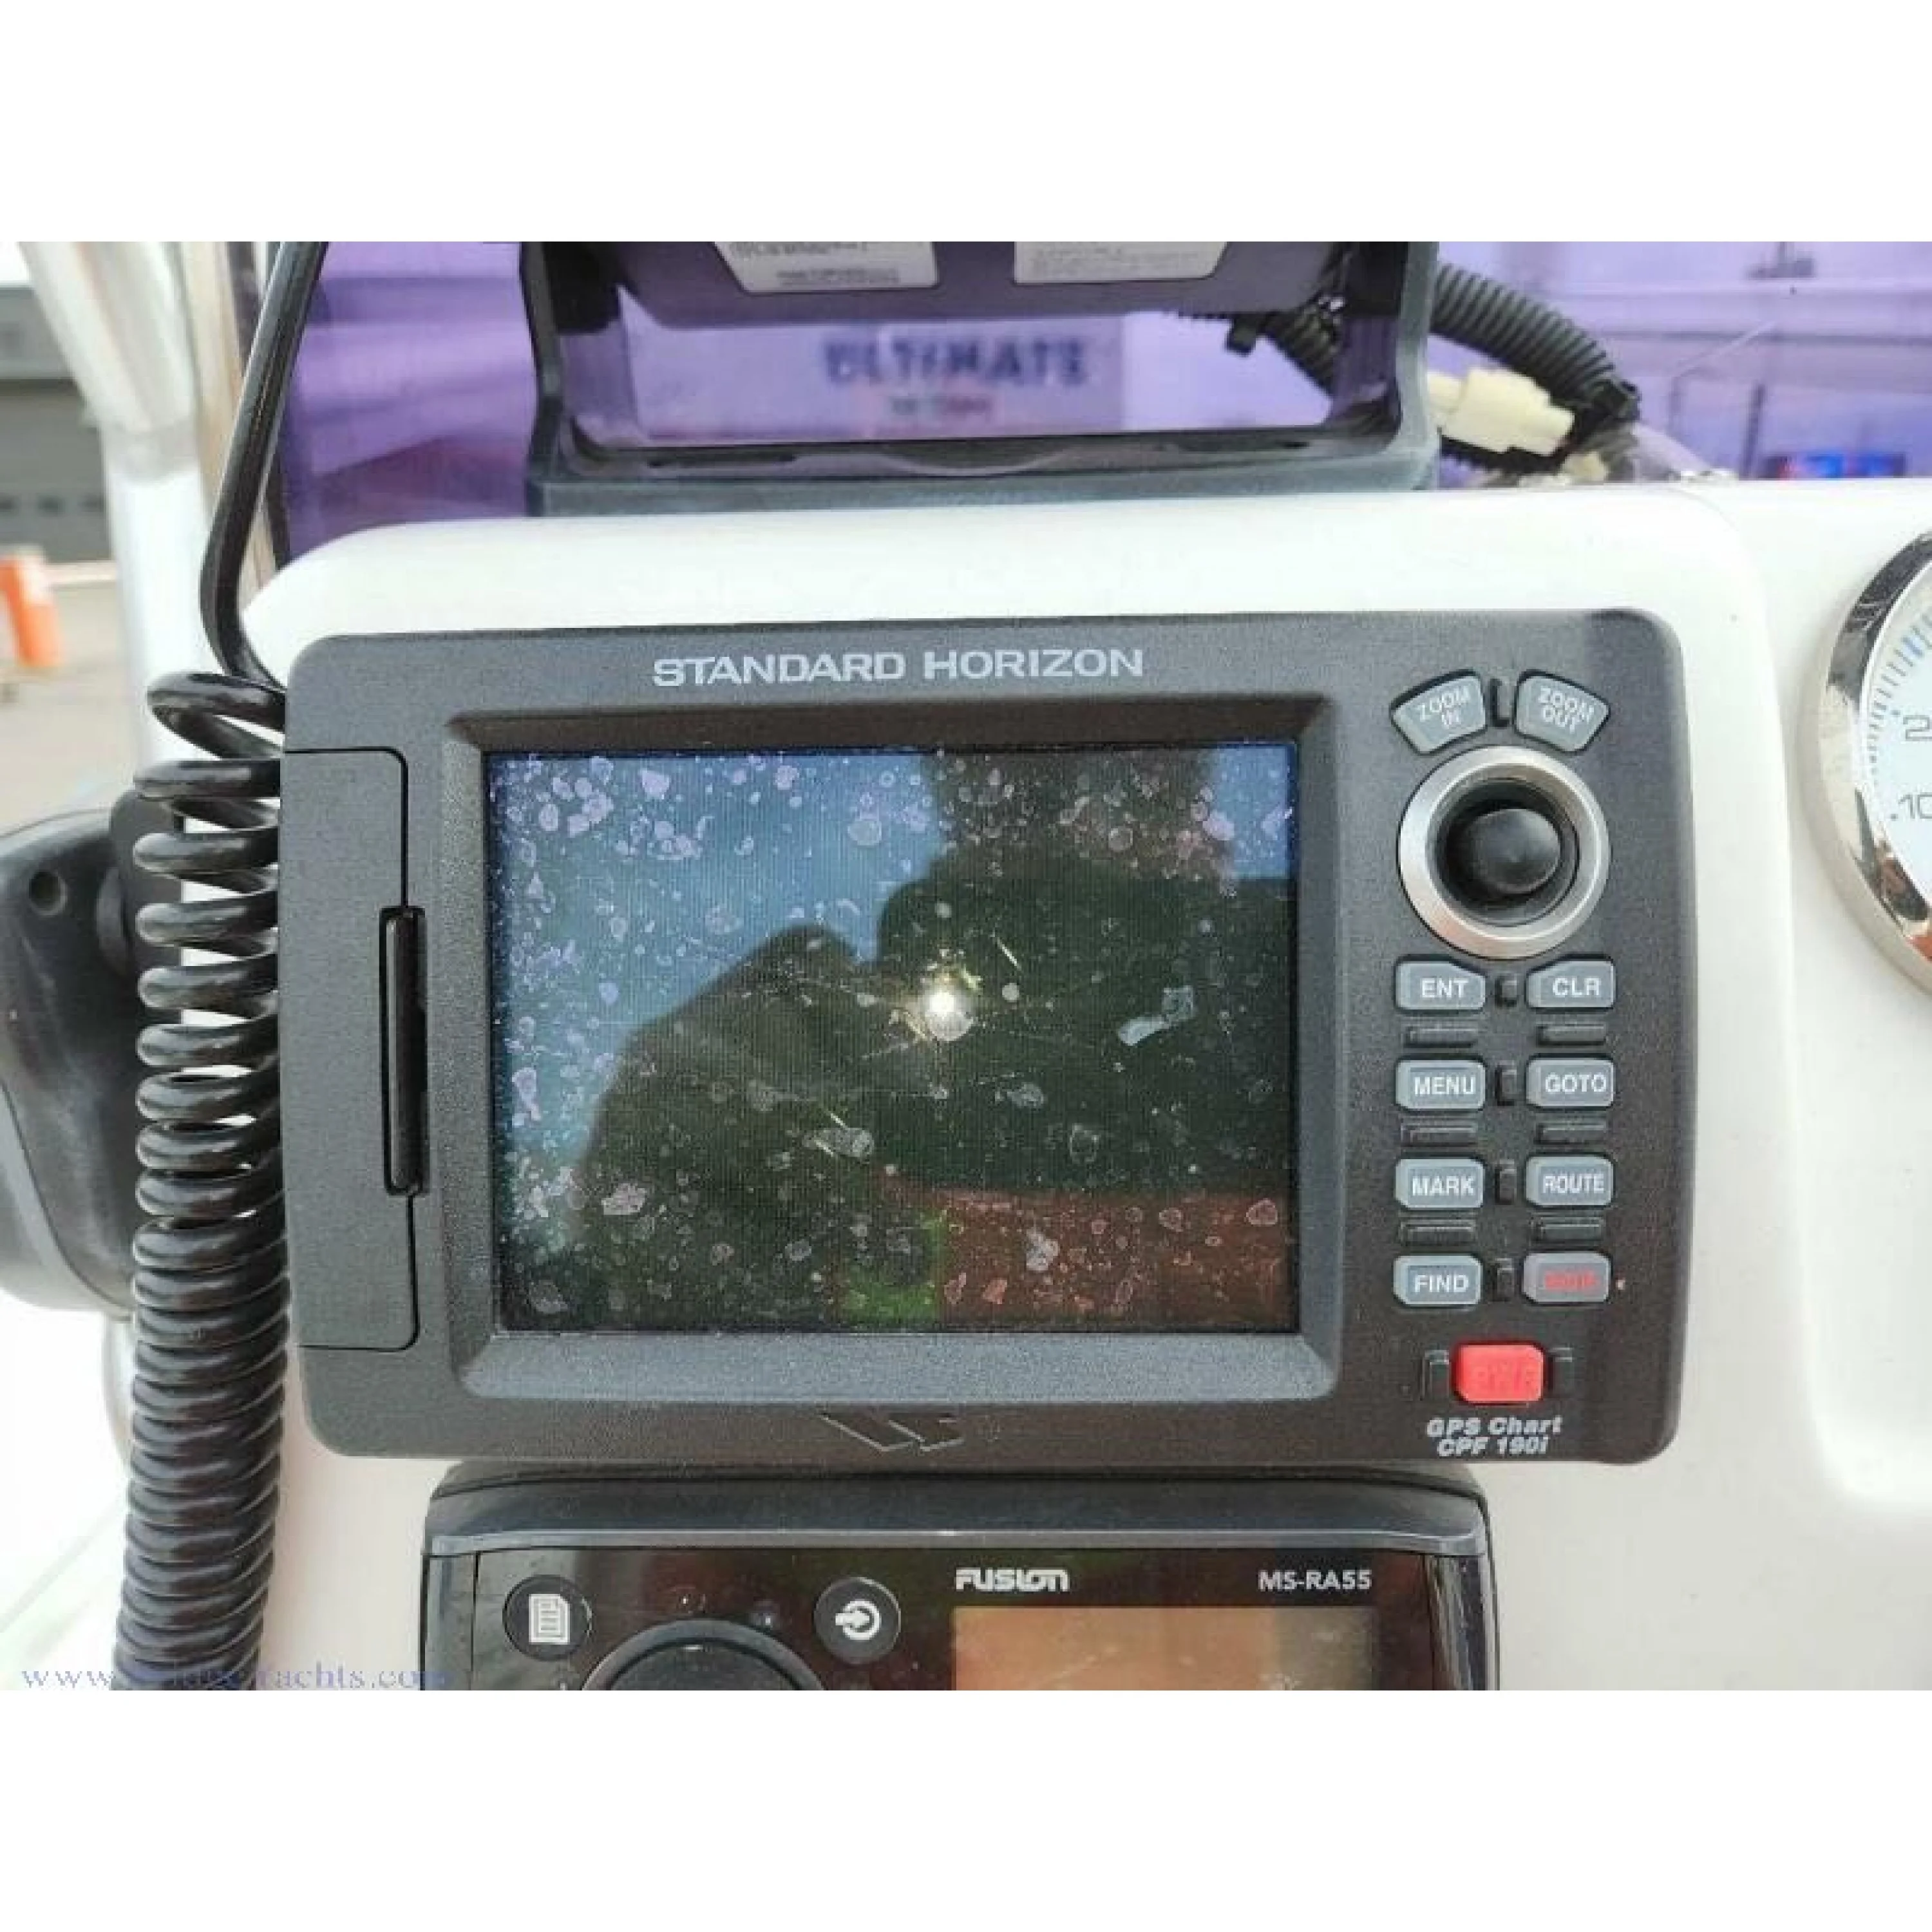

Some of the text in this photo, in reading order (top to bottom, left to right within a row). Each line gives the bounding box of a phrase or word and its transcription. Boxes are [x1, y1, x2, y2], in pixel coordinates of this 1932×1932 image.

[652, 648, 1144, 687] STANDARD HORIZON
[1417, 687, 1472, 722] ZOOM
[1538, 687, 1595, 723] ZOOM
[1542, 708, 1580, 734] OUT
[1421, 978, 1468, 999] ENT
[1552, 977, 1603, 997] CLR
[1414, 1075, 1477, 1095] MENU
[1545, 1073, 1607, 1093] GOTO
[1412, 1175, 1477, 1196] MARK
[1542, 1173, 1605, 1194] ROUTE
[1414, 1274, 1470, 1293] FIND
[1426, 1414, 1563, 1437] GPS Chart
[1258, 1568, 1373, 1592] MS-RA55
